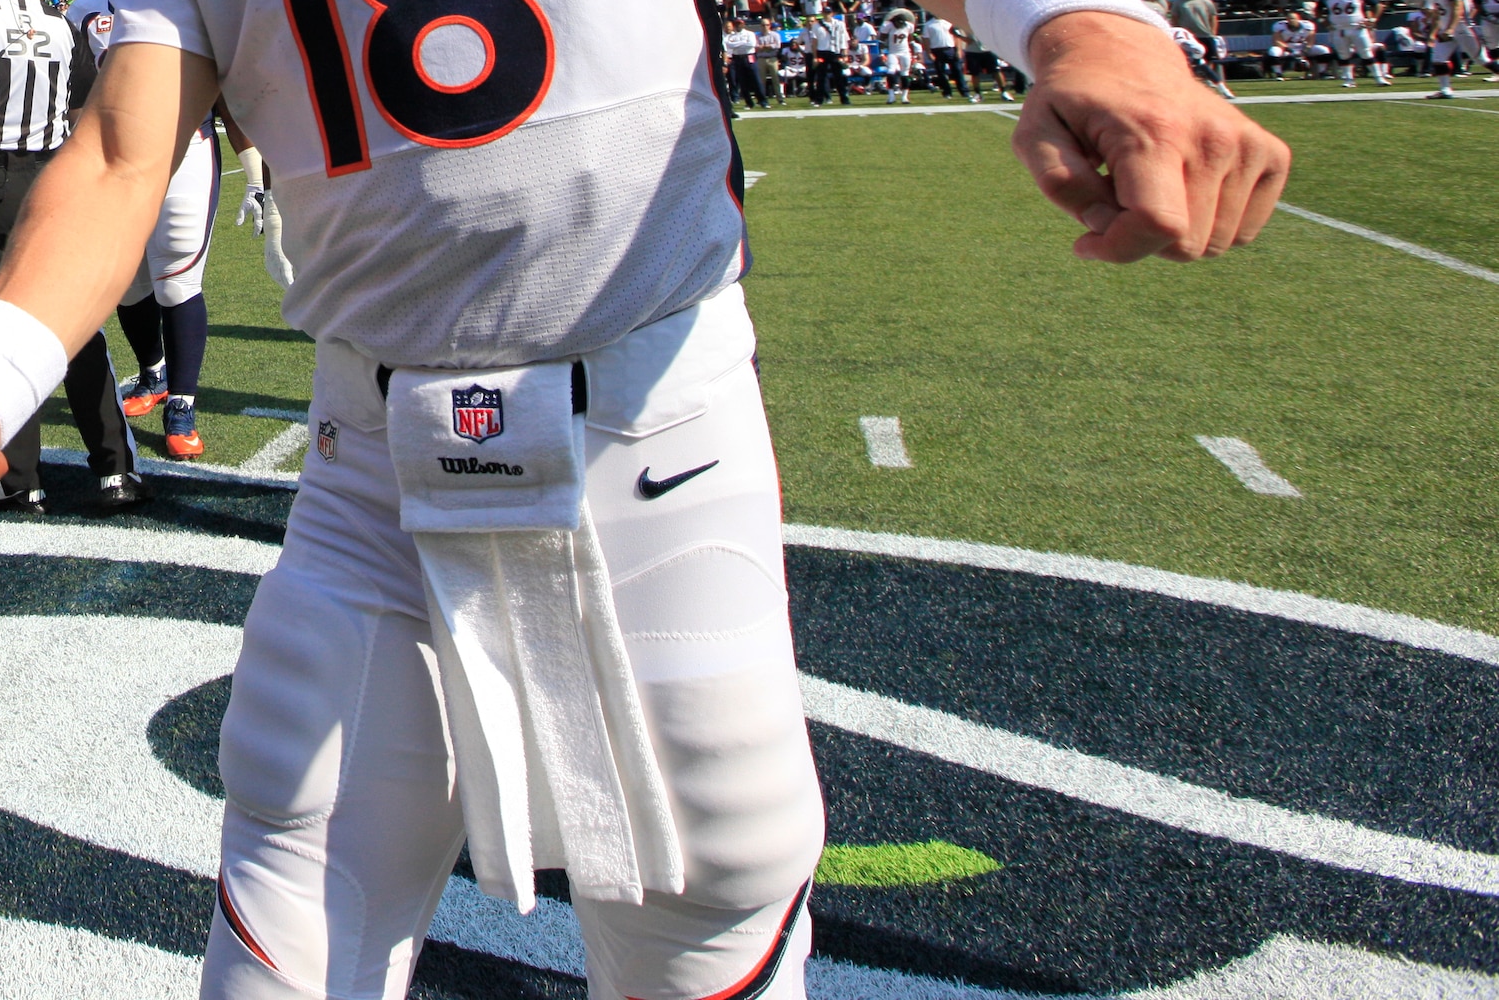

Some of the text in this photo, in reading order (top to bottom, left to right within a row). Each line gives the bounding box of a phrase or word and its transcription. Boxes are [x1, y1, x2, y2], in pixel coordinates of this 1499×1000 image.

[1332, 2, 1356, 15] 66
[6, 29, 52, 58] 52
[893, 34, 906, 44] 19
[457, 408, 500, 438] NFL
[319, 435, 335, 457] NFL
